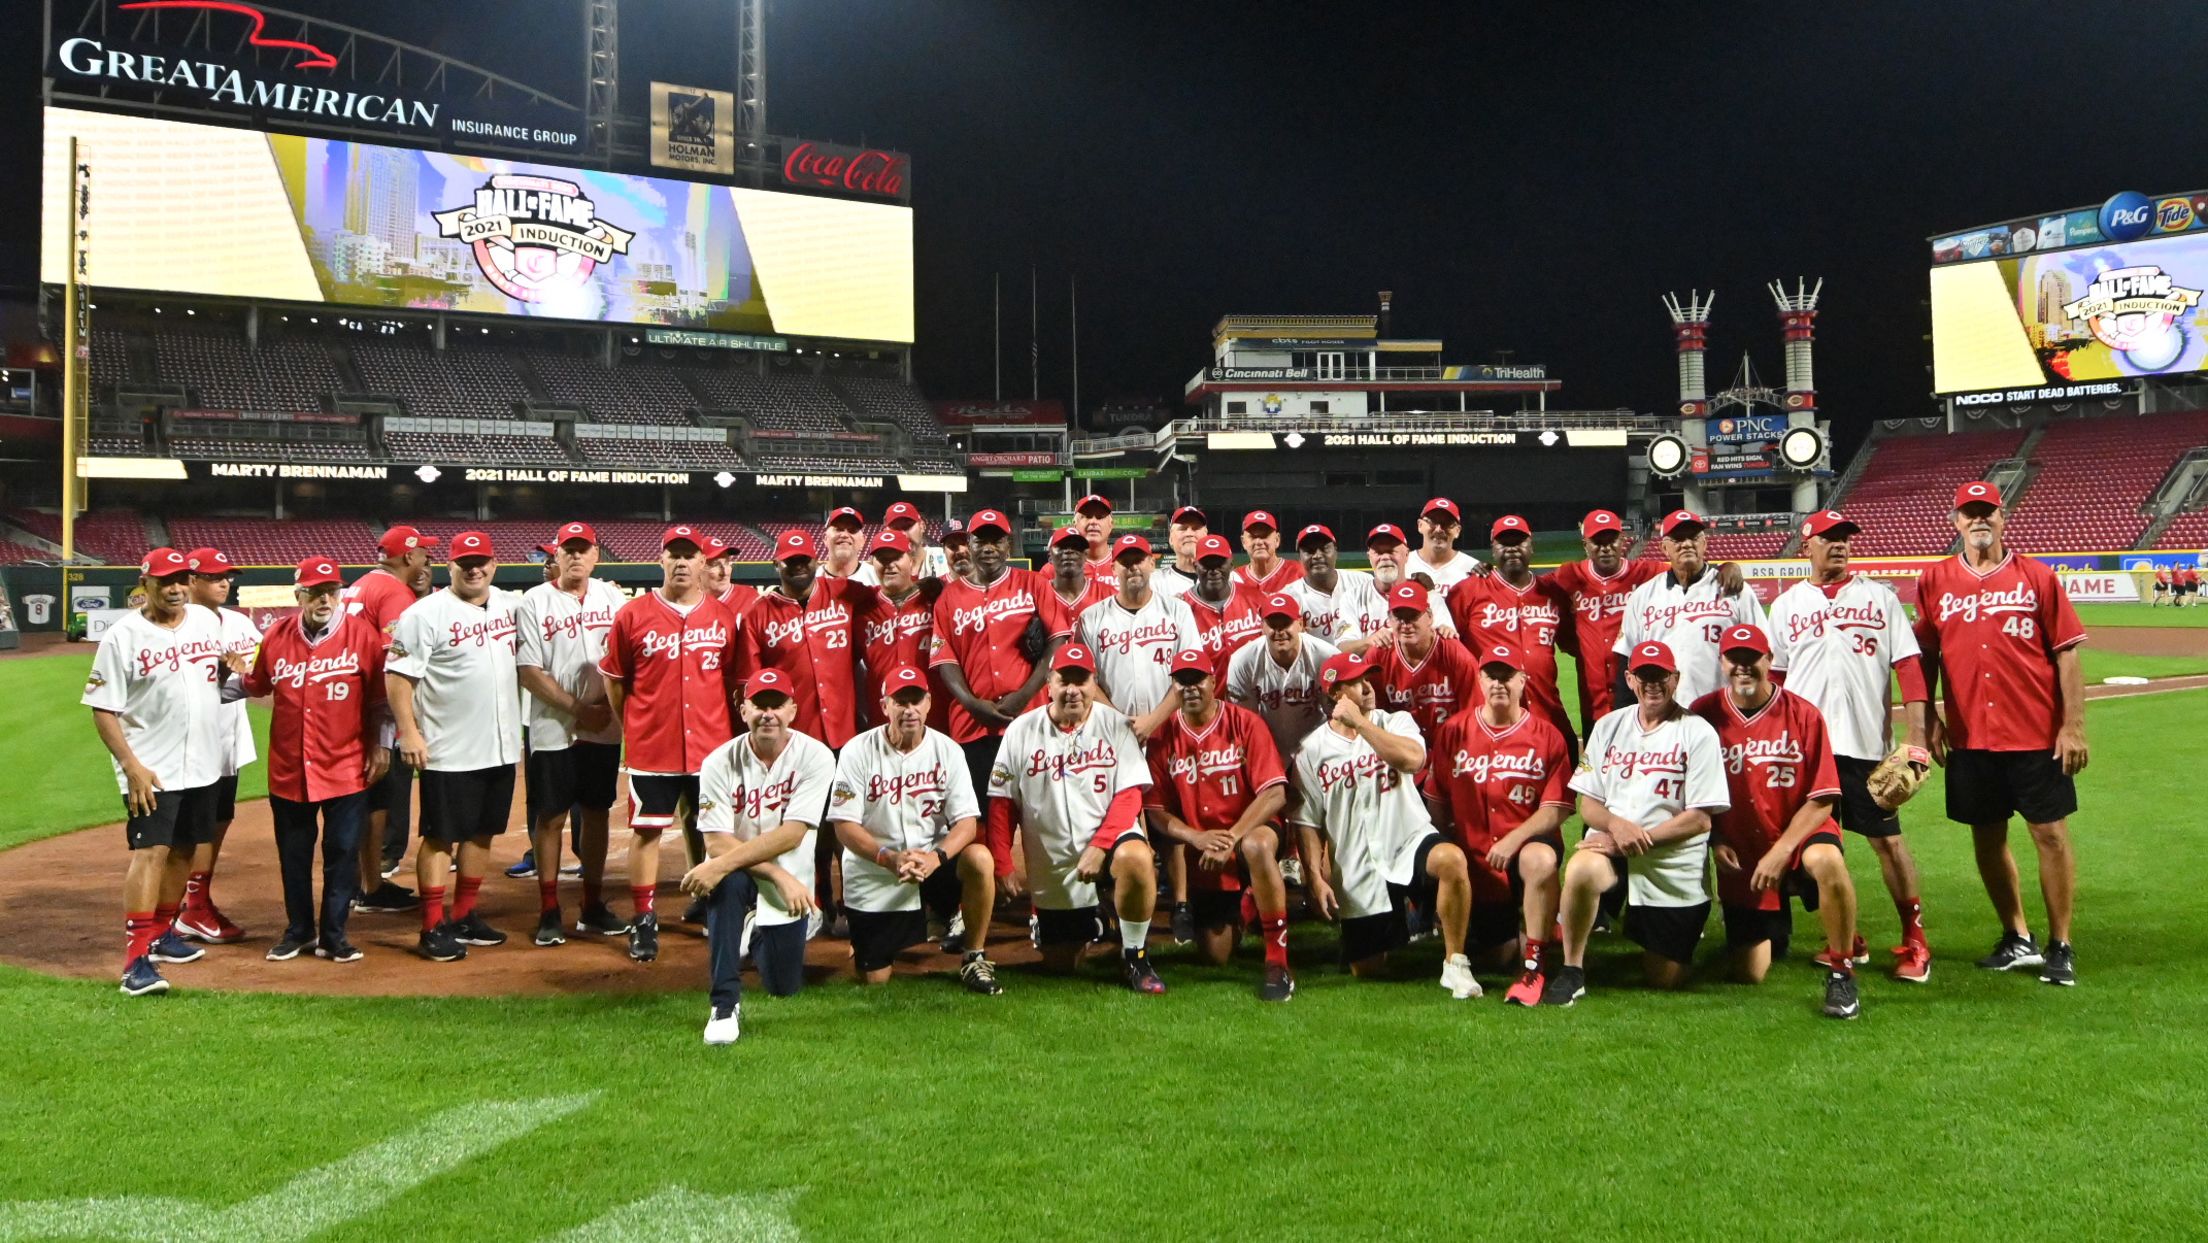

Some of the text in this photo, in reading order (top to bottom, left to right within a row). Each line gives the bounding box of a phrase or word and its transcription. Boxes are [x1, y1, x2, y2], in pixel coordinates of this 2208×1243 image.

[452, 119, 577, 145] INSURANCE GROUP
[669, 143, 715, 157] HOLMAN
[538, 191, 595, 229] FAME
[2110, 206, 2149, 227] P&G
[2159, 203, 2191, 226] Tide
[464, 221, 605, 258] 2021 INDUCTION
[2131, 275, 2172, 296] FAME
[2083, 301, 2180, 315] 2021 INDUCTION
[648, 334, 706, 346] ULTIMATE
[730, 340, 782, 351] SHUTTLE
[1225, 368, 1308, 378] Cincinnati Bell
[1494, 366, 1545, 379] TriHealth
[1956, 383, 2122, 405] NOCO START DEAD BATTERIES.
[1736, 418, 1773, 432] PNC
[1324, 433, 1516, 445] 2021 HALL OF FAME INDUCTION
[1710, 431, 1784, 442] POWER STACKS
[1028, 455, 1051, 464] PATIO
[211, 463, 388, 479] MARTY BRENNAMAN
[465, 468, 689, 484] 2021 HALL OF FAME INDUCTION
[756, 475, 883, 487] MARTY BRENNAMAN
[68, 573, 84, 581] 328
[1780, 567, 1811, 577] GROU
[2069, 579, 2116, 594] AME
[35, 603, 43, 615] 8
[80, 599, 103, 609] Ford
[953, 589, 1036, 636] Legends
[1573, 585, 1637, 622] Legend
[1643, 594, 1734, 631] Legends
[1939, 581, 2038, 623] Legends
[542, 605, 613, 641] Legend
[766, 600, 849, 648] Legends
[1302, 608, 1339, 637] Lege
[1481, 598, 1560, 632] Legends
[1789, 601, 1886, 642] Legends
[449, 609, 517, 647] Legend
[1098, 618, 1178, 655] Legends
[1200, 608, 1264, 651] egends
[1702, 624, 1722, 643] 13
[2002, 616, 2034, 640] 48
[224, 634, 258, 651] ends
[642, 620, 727, 659] Legends
[825, 630, 847, 649] 23
[1853, 634, 1877, 657] 36
[138, 634, 222, 676] Legends
[702, 651, 721, 670] 25
[1153, 648, 1173, 665] 48
[271, 648, 359, 688] Legends
[325, 682, 349, 700] 19
[1385, 676, 1455, 704] Legend
[1027, 739, 1117, 782] Legends
[1168, 743, 1247, 785] Legends
[1601, 743, 1687, 780] Legends
[1721, 731, 1804, 775] egends
[1317, 751, 1387, 793] Legen
[1452, 749, 1545, 784] Legends
[1766, 767, 1796, 788] 25
[867, 762, 947, 805] Legends
[1093, 774, 1107, 793] 5
[1219, 775, 1238, 796] 11
[1377, 766, 1400, 793] 29
[1654, 779, 1685, 801] 47
[732, 771, 800, 818] Lgend
[921, 800, 945, 818] 23
